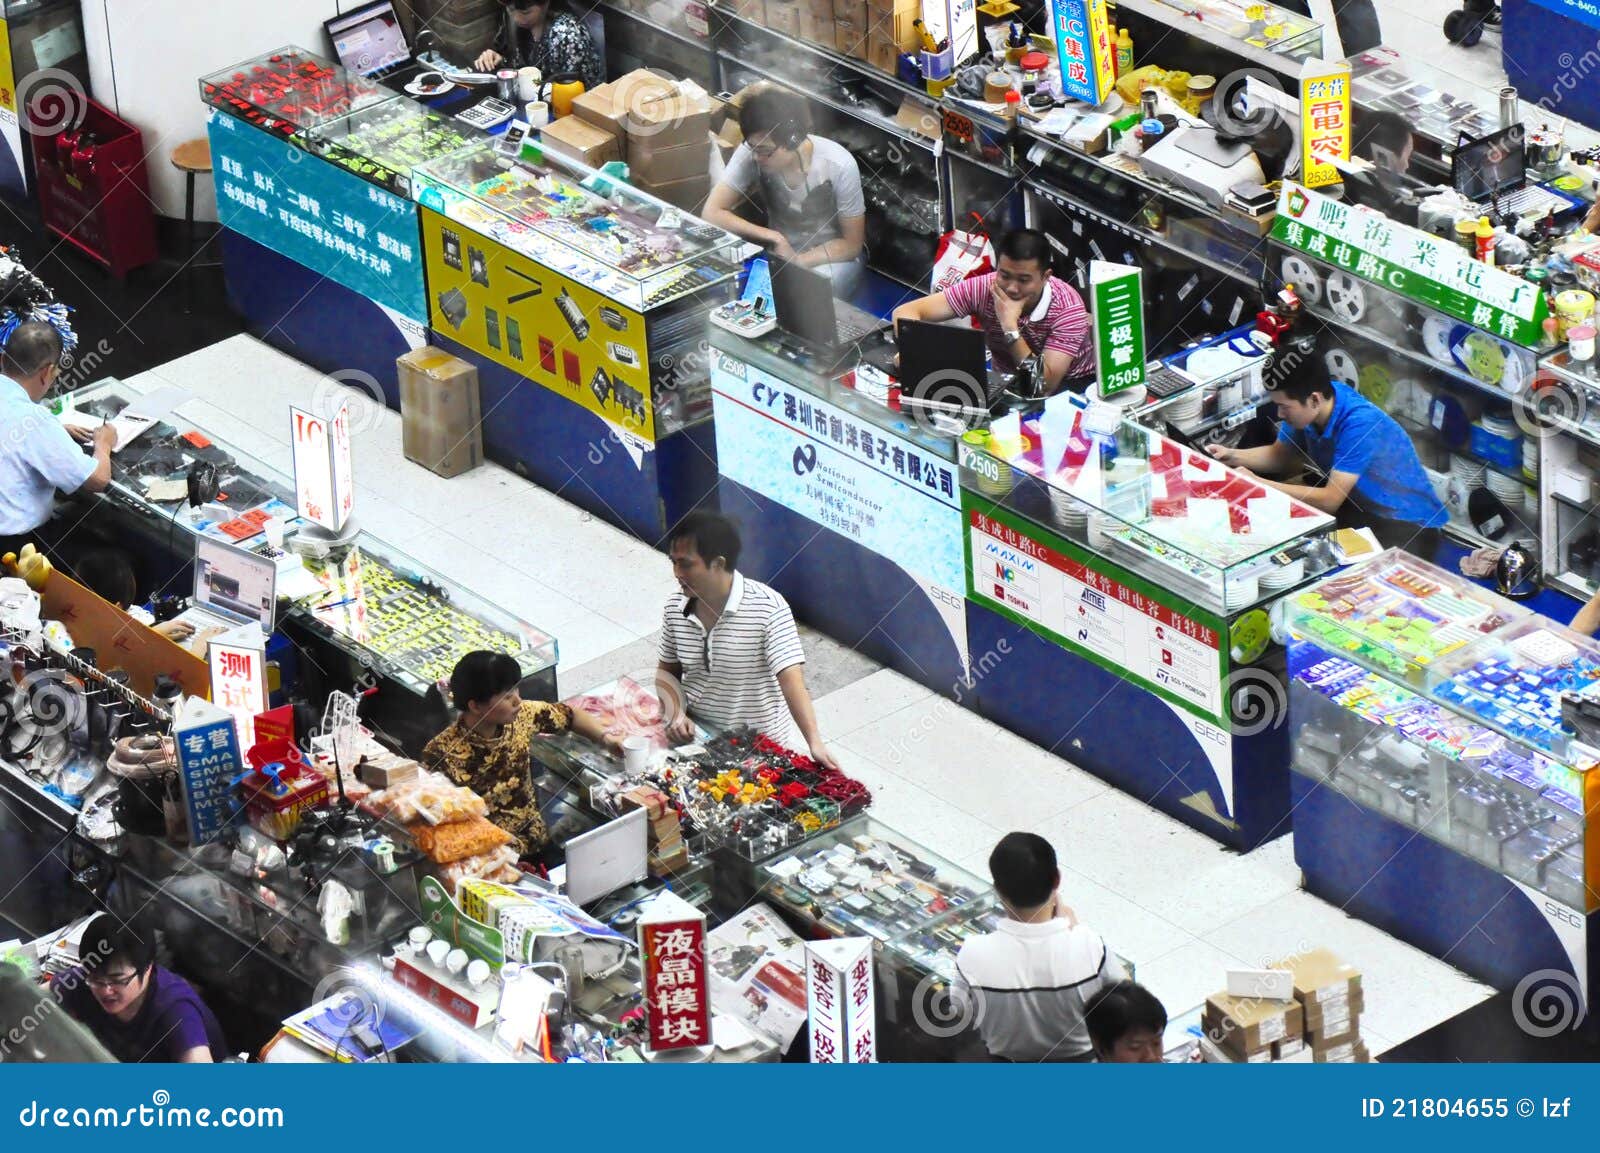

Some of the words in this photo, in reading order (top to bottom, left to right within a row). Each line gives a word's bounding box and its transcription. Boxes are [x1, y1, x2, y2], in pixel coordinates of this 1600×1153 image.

[1059, 14, 1084, 37] IC
[1106, 283, 1135, 367] 二三极管
[721, 359, 746, 378] 2508
[1107, 367, 1141, 390] 2509
[752, 381, 780, 408] CY
[816, 460, 857, 487] National
[968, 453, 1000, 482] 2509
[815, 473, 884, 513] Semiconductor
[985, 542, 1035, 572] MAXIM
[929, 585, 962, 611] SEG
[1006, 593, 1030, 612] TOSHIBA
[183, 728, 230, 753] 专营
[1194, 720, 1228, 747] SEG
[187, 752, 233, 769] SMA
[1544, 901, 1582, 929] SEG
[653, 928, 700, 1044] 液晶模块
